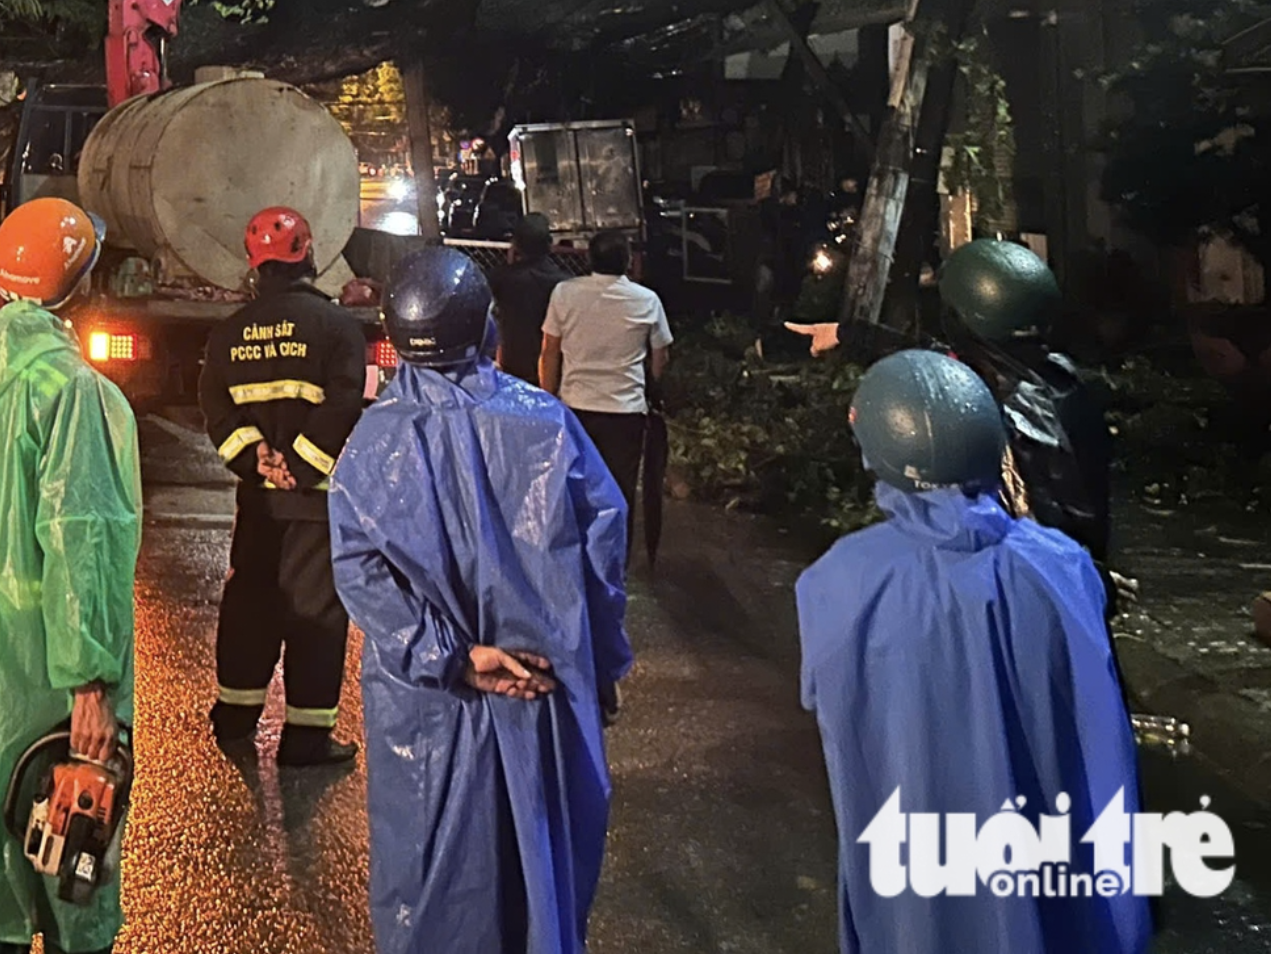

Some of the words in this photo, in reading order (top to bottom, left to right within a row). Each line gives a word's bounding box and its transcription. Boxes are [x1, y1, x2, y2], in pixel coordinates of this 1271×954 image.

[243, 322, 274, 341] CẢNH
[274, 319, 295, 338] SÁT
[230, 345, 261, 362] PCCC
[263, 341, 277, 358] VÀ
